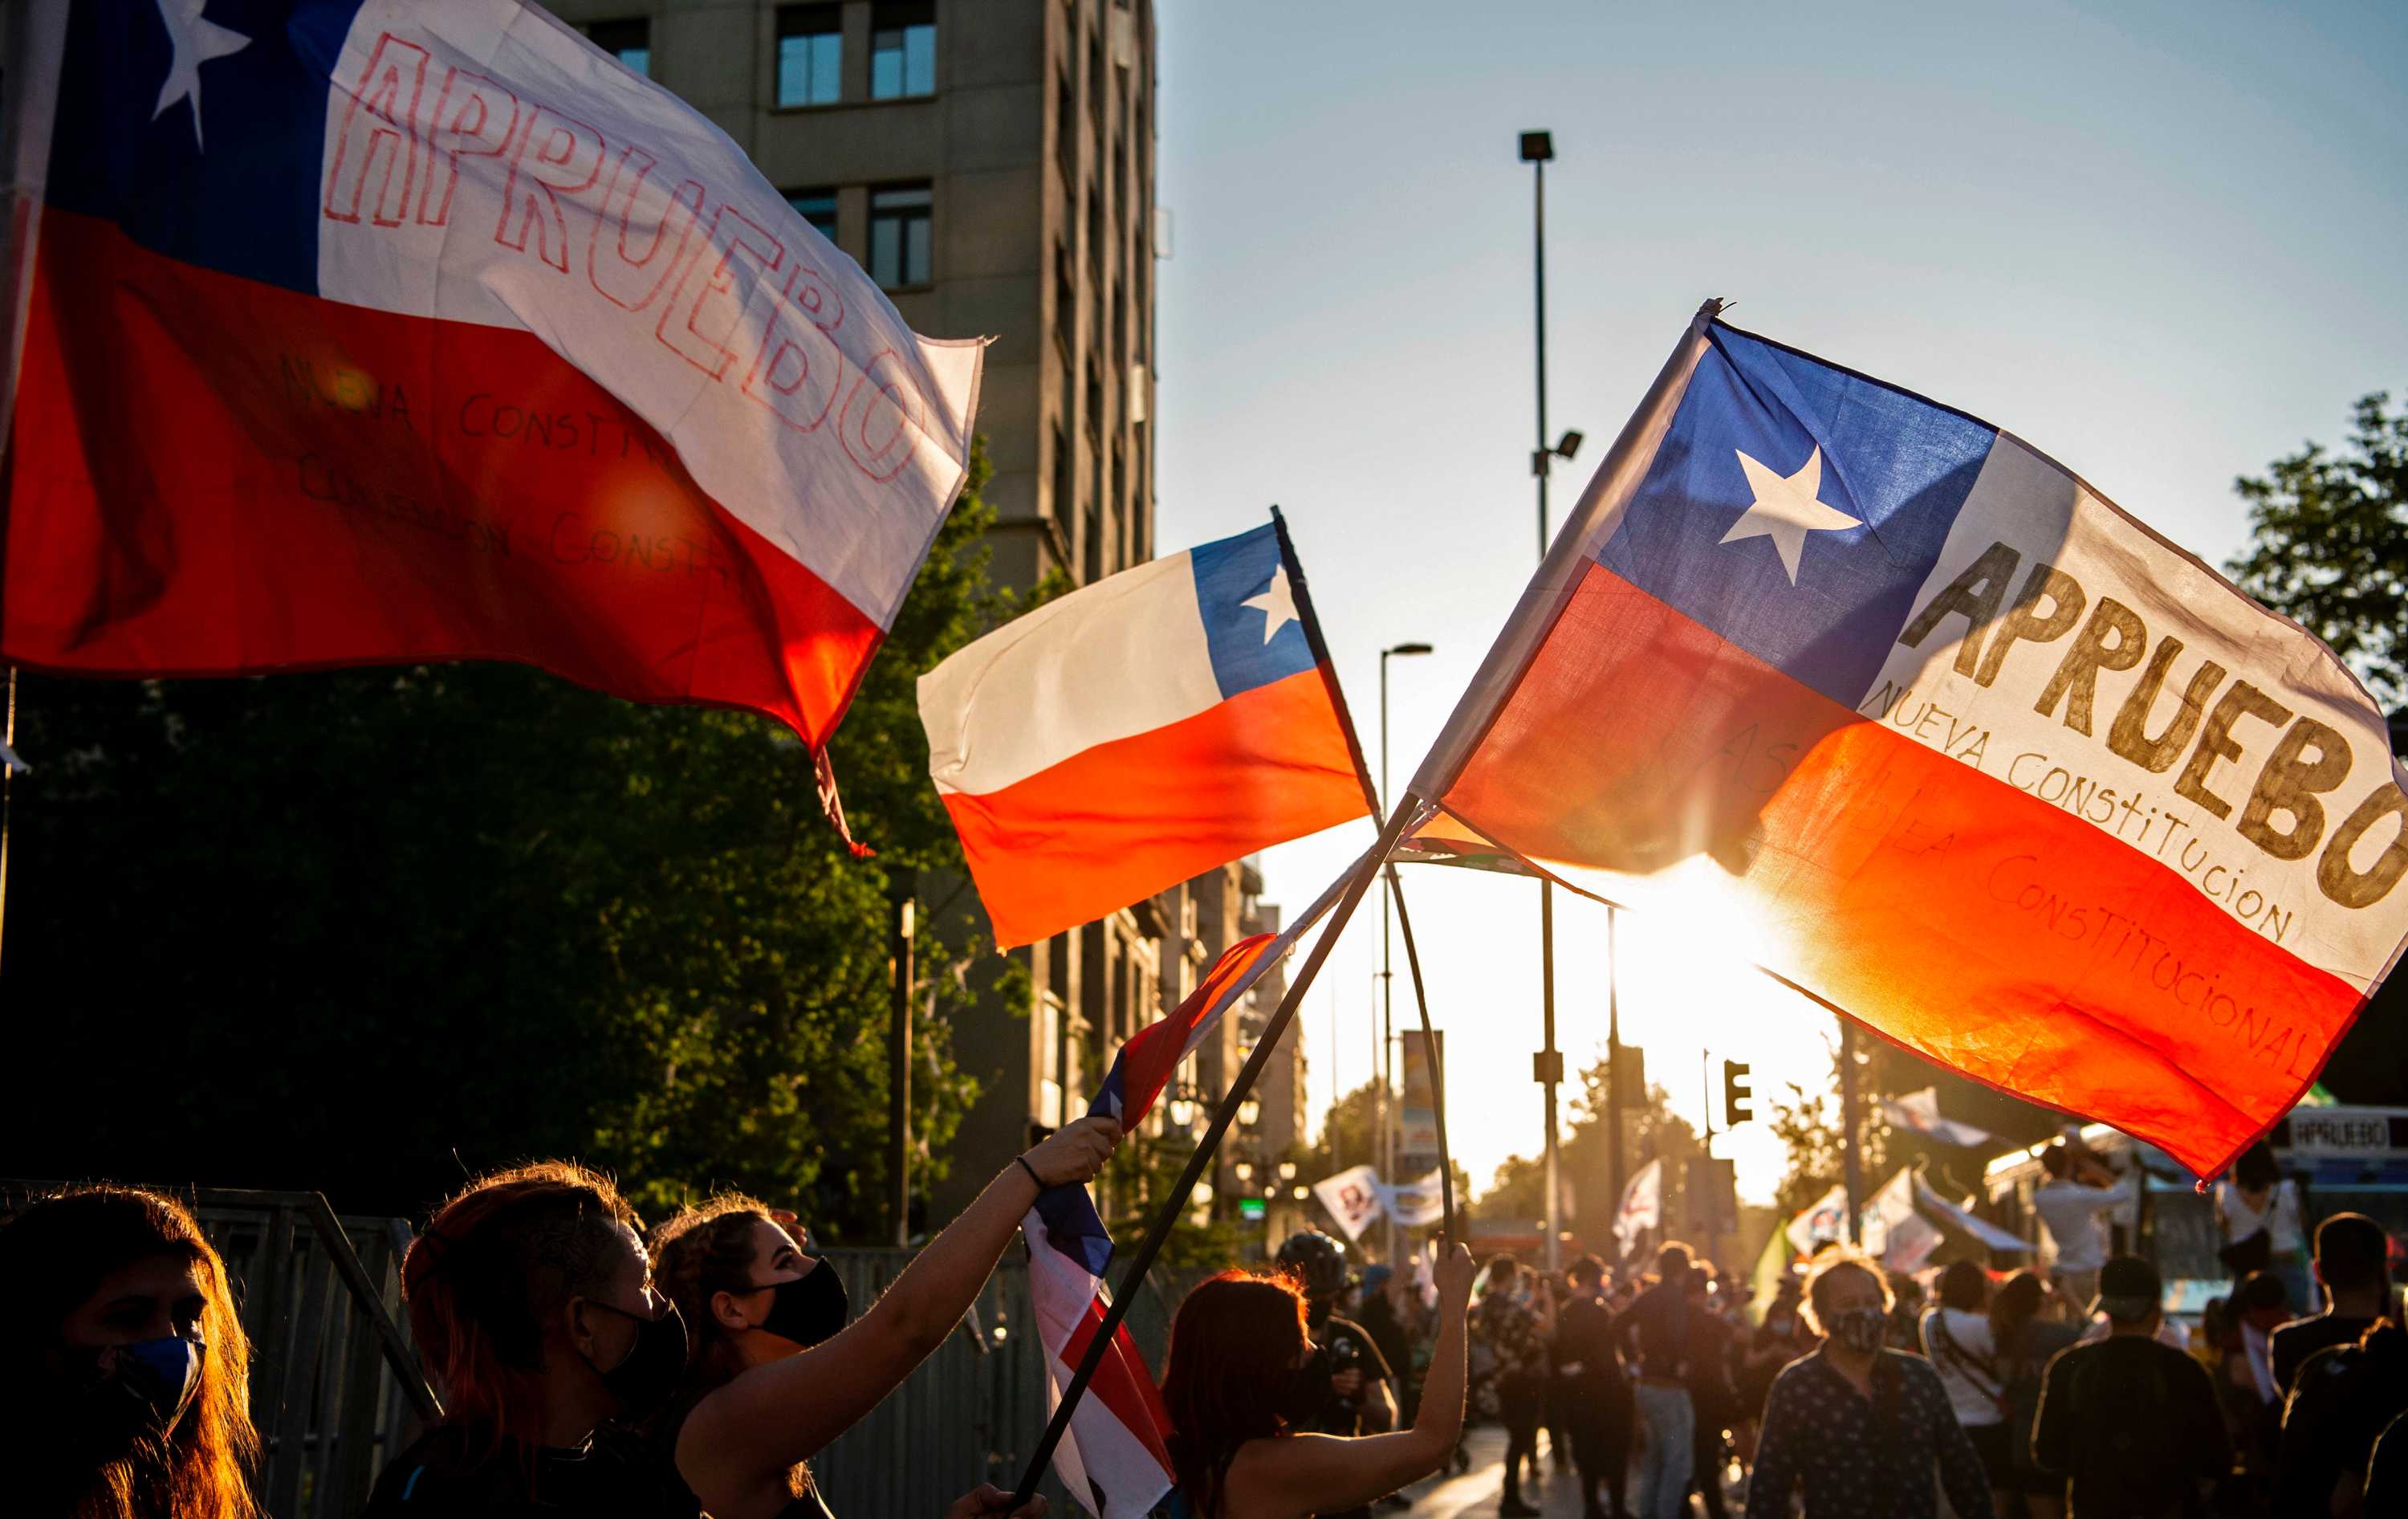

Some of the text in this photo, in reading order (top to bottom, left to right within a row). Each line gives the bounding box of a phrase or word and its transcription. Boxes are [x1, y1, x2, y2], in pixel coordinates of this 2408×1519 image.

[323, 31, 925, 483] APRUEBO
[1860, 680, 1990, 769] NUEVA
[1898, 540, 2408, 910] APRUEBO
